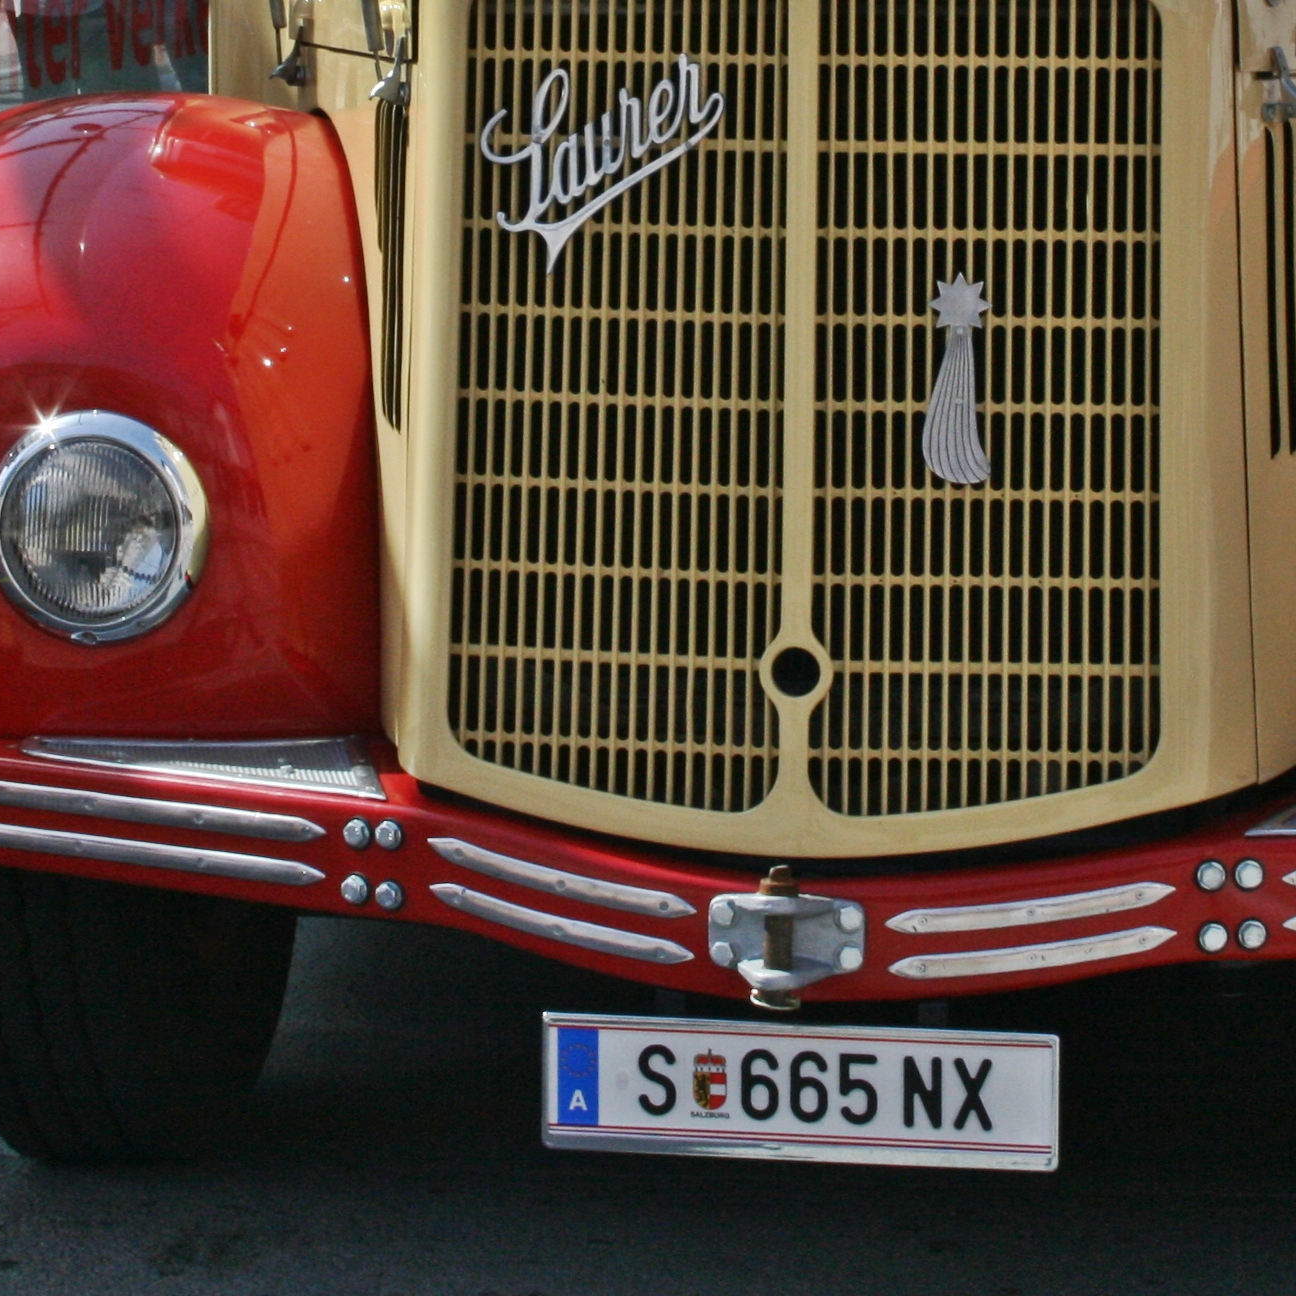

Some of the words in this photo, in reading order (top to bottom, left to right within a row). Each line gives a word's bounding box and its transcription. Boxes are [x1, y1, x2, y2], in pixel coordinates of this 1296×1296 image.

[568, 1090, 588, 1112] A
[638, 1044, 677, 1116] S
[740, 1048, 879, 1125] 665
[903, 1055, 994, 1132] NX
